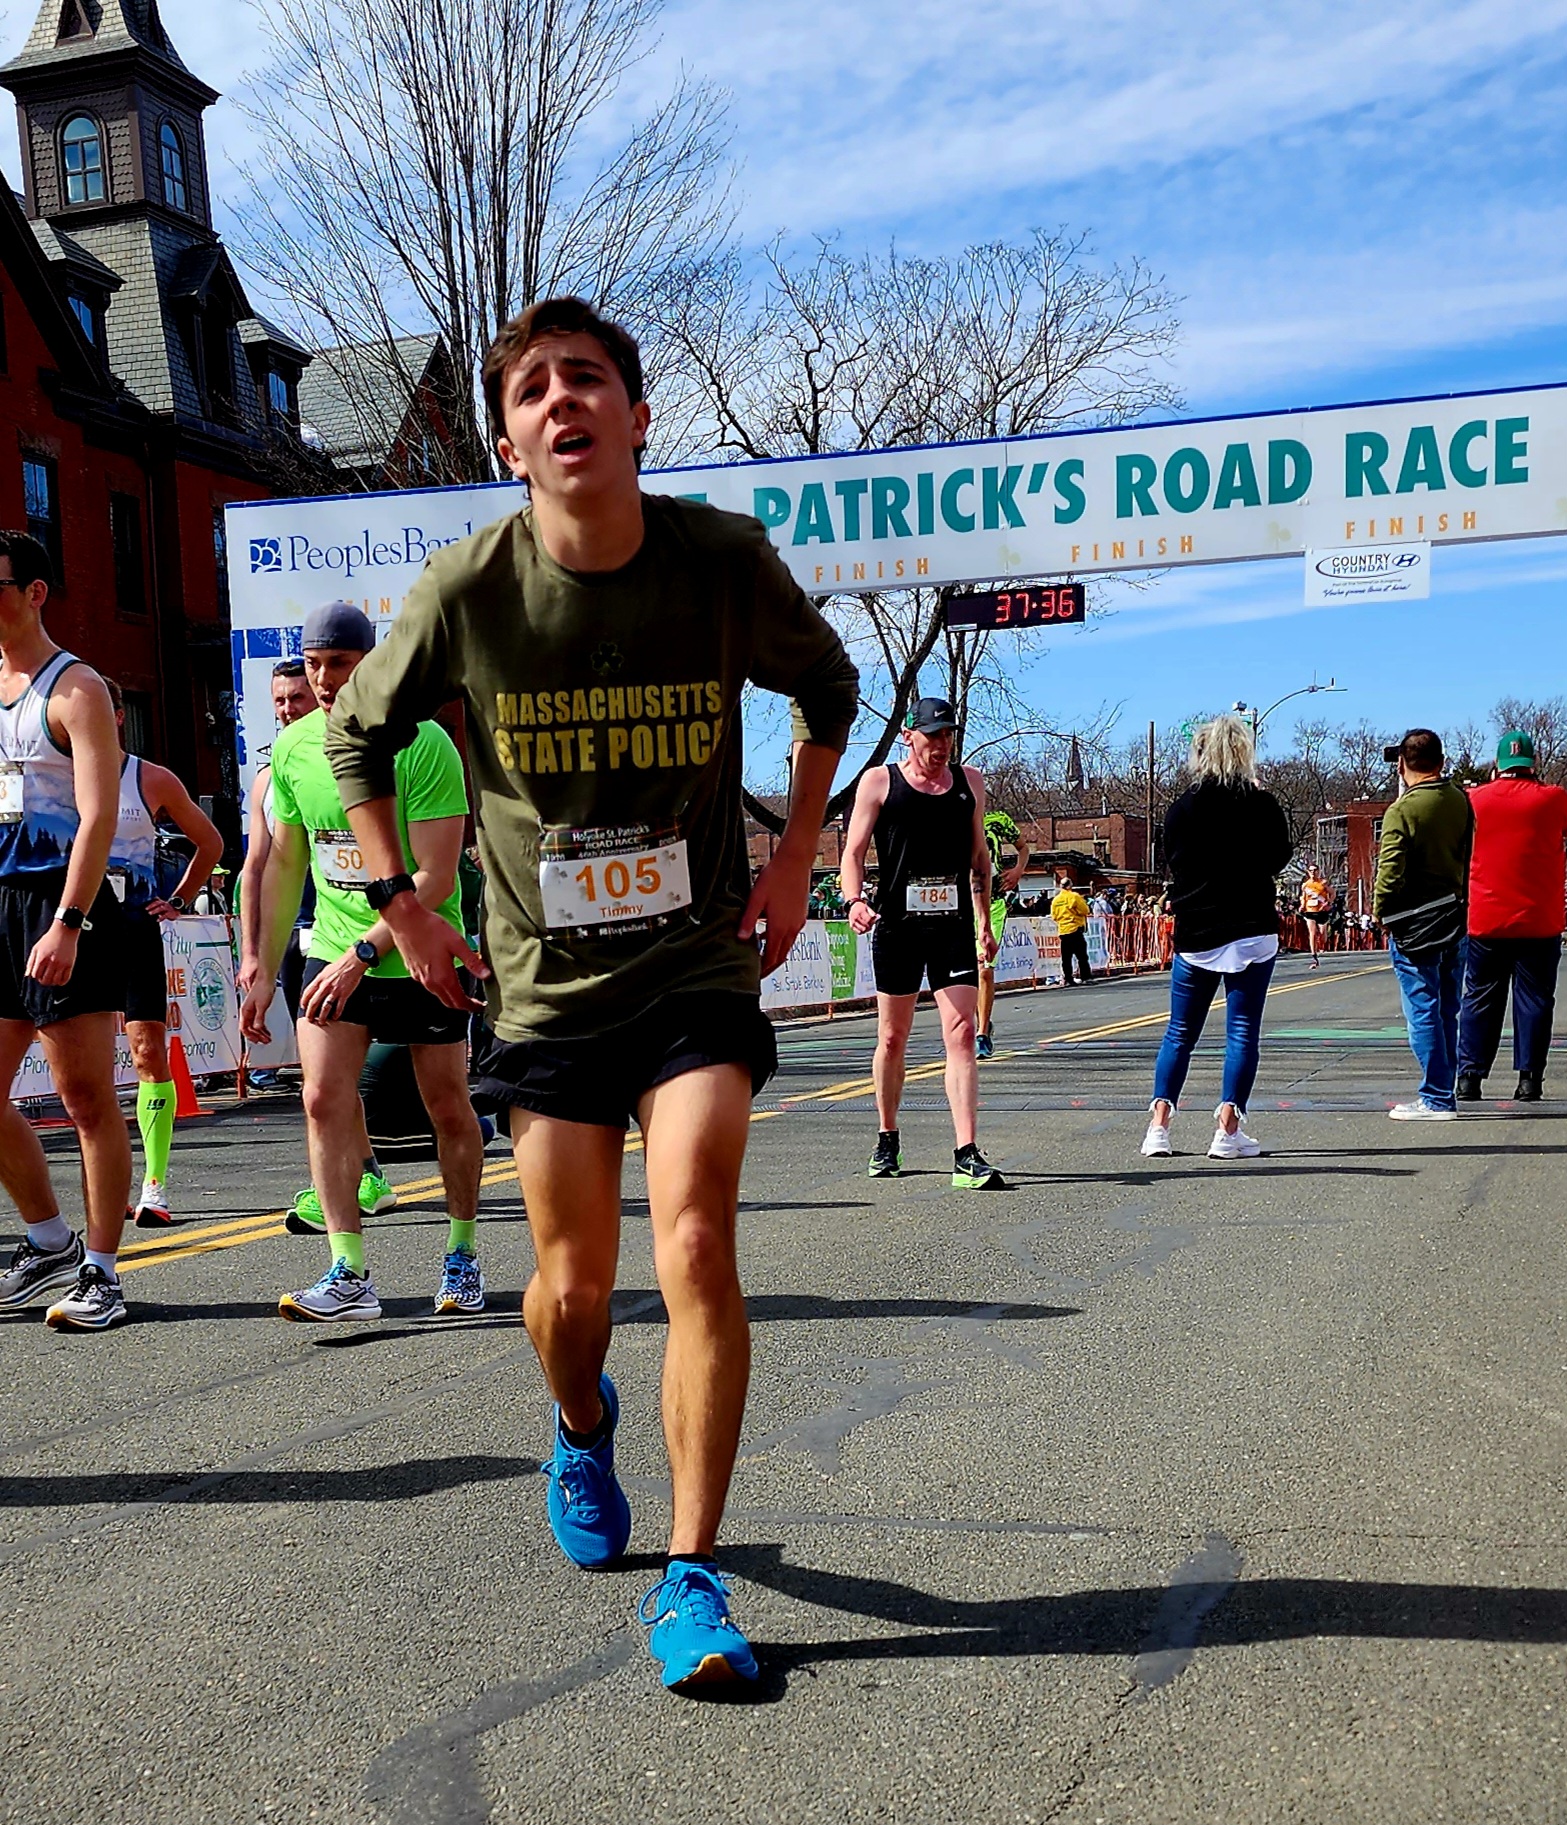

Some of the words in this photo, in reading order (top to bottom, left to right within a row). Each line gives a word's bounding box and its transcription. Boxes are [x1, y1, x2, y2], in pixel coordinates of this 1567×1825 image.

[1115, 439, 1313, 519] ROAD
[1345, 416, 1530, 499] RACE
[1345, 511, 1477, 540] FINISH
[1071, 535, 1194, 563] FINISH
[1332, 552, 1391, 568] COUNTRY
[815, 557, 930, 583] FINISH
[1333, 563, 1388, 575] HYUNDAI
[496, 680, 723, 726] MASSACHUSETTS
[494, 727, 596, 775] STATE
[337, 849, 364, 870] 50
[575, 855, 662, 903] 105
[919, 887, 948, 904] 184
[599, 904, 644, 919] Timmy
